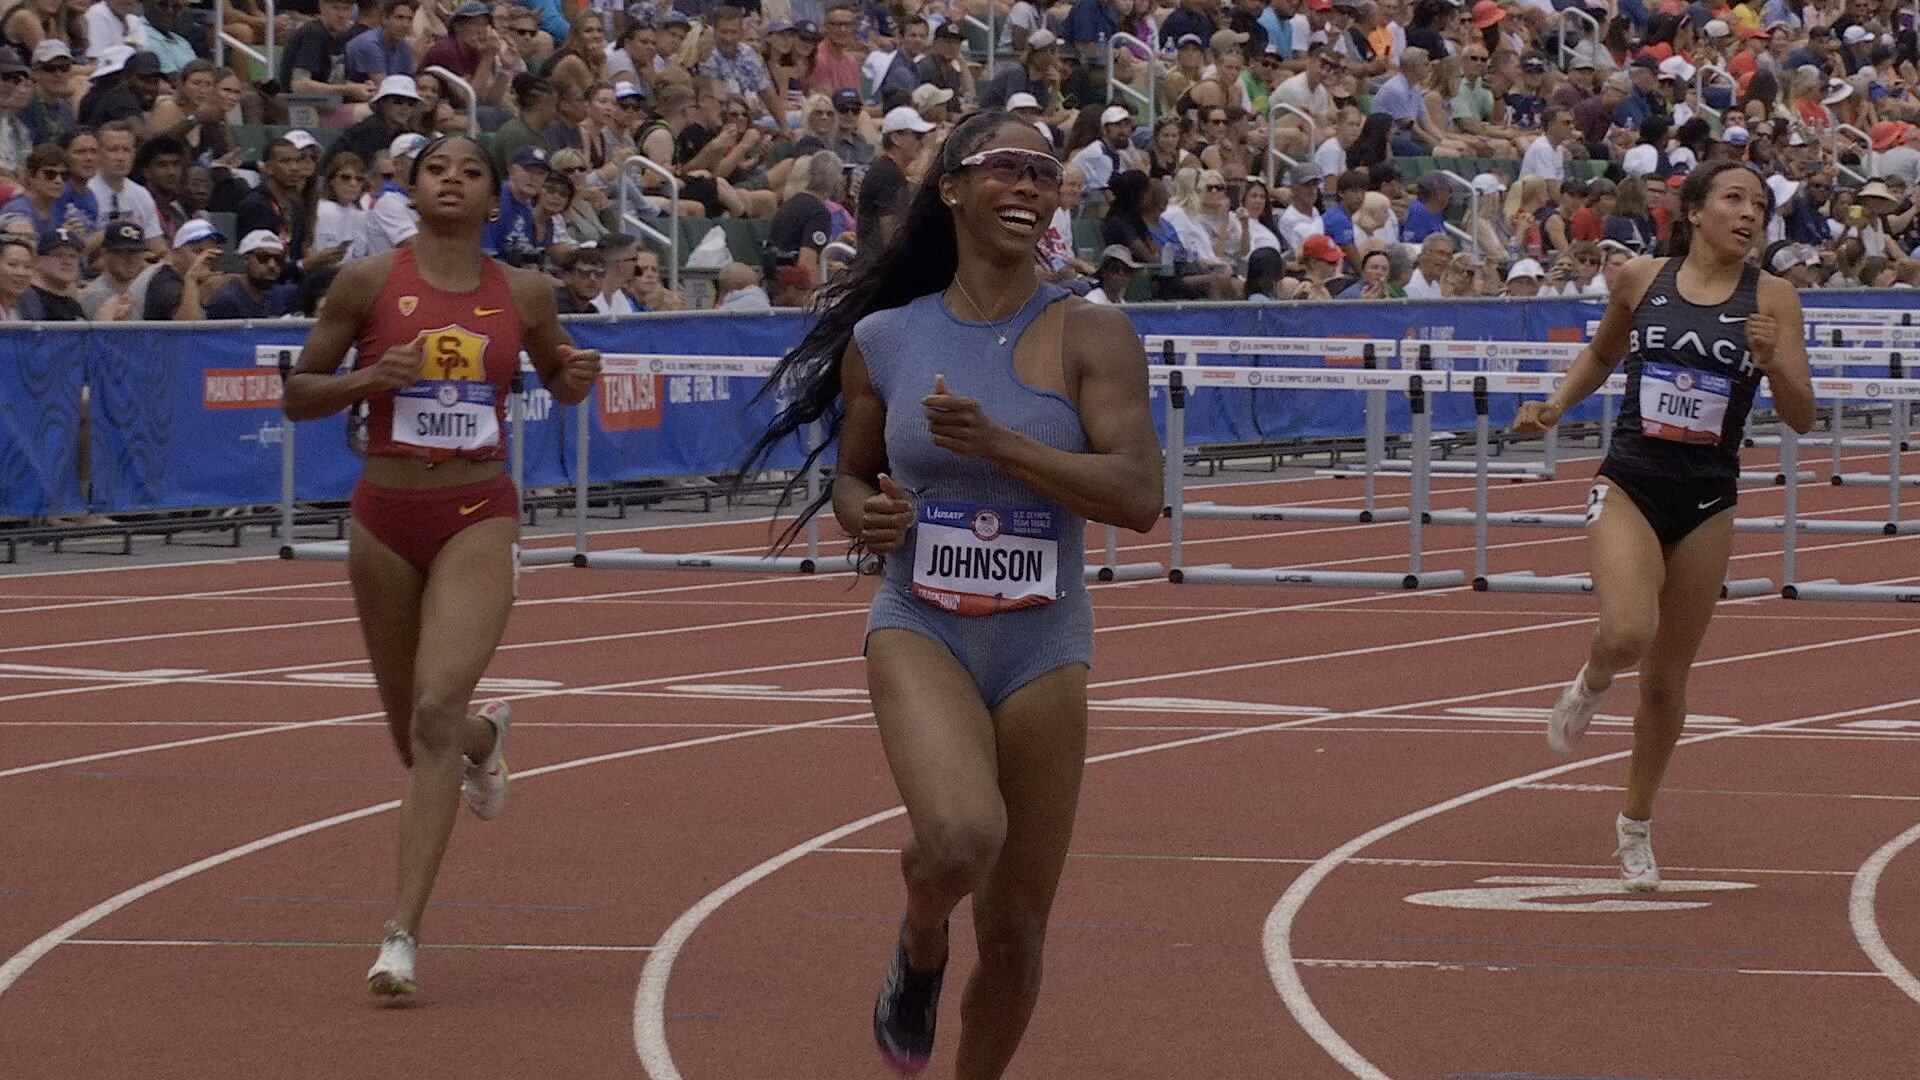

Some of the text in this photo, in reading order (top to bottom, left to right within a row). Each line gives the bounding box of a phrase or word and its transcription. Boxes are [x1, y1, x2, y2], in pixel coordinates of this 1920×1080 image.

[1629, 324, 1758, 377] BEACH
[1657, 392, 1703, 420] FUNE
[416, 411, 478, 438] SMITH
[926, 544, 1043, 582] JOHNSON
